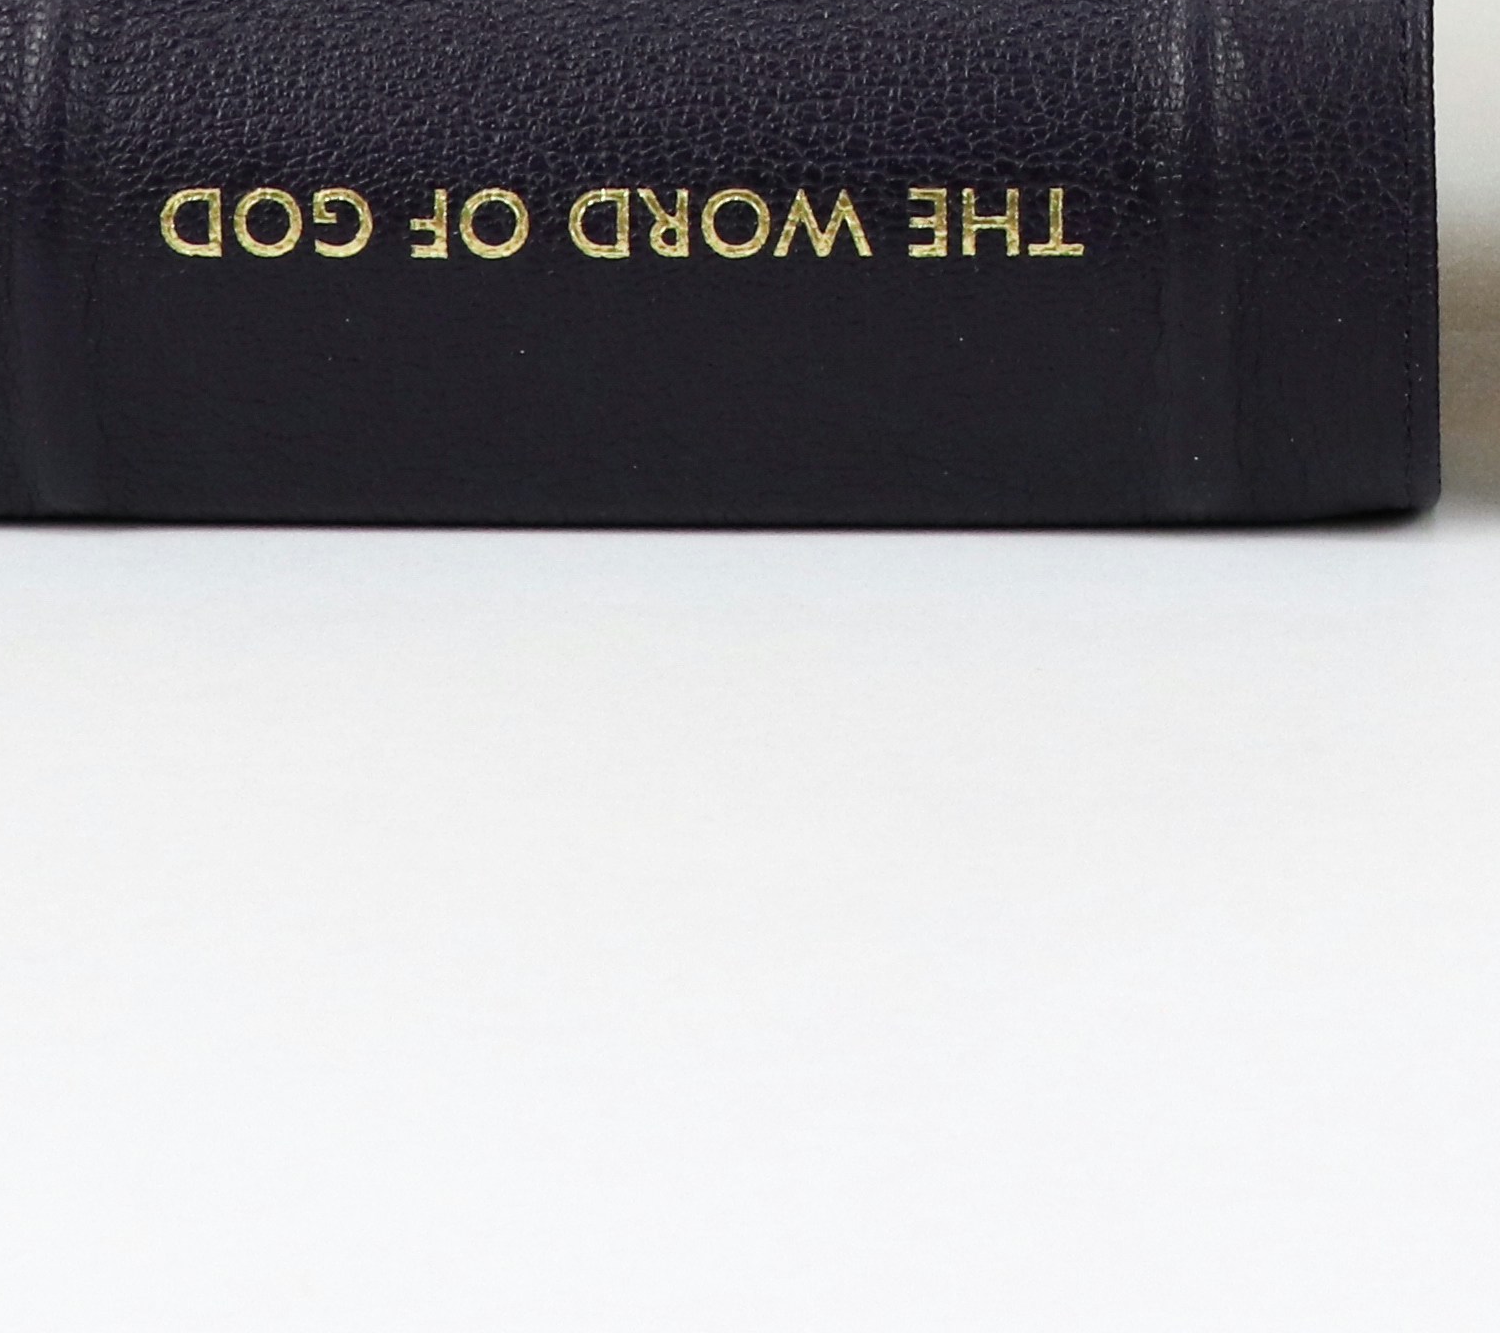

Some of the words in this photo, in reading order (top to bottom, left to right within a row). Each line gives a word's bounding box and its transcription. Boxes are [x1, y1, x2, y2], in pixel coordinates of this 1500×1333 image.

[159, 187, 373, 258] GOD
[409, 187, 529, 259] OF
[568, 187, 873, 259] WORD
[908, 187, 1085, 258] THE
